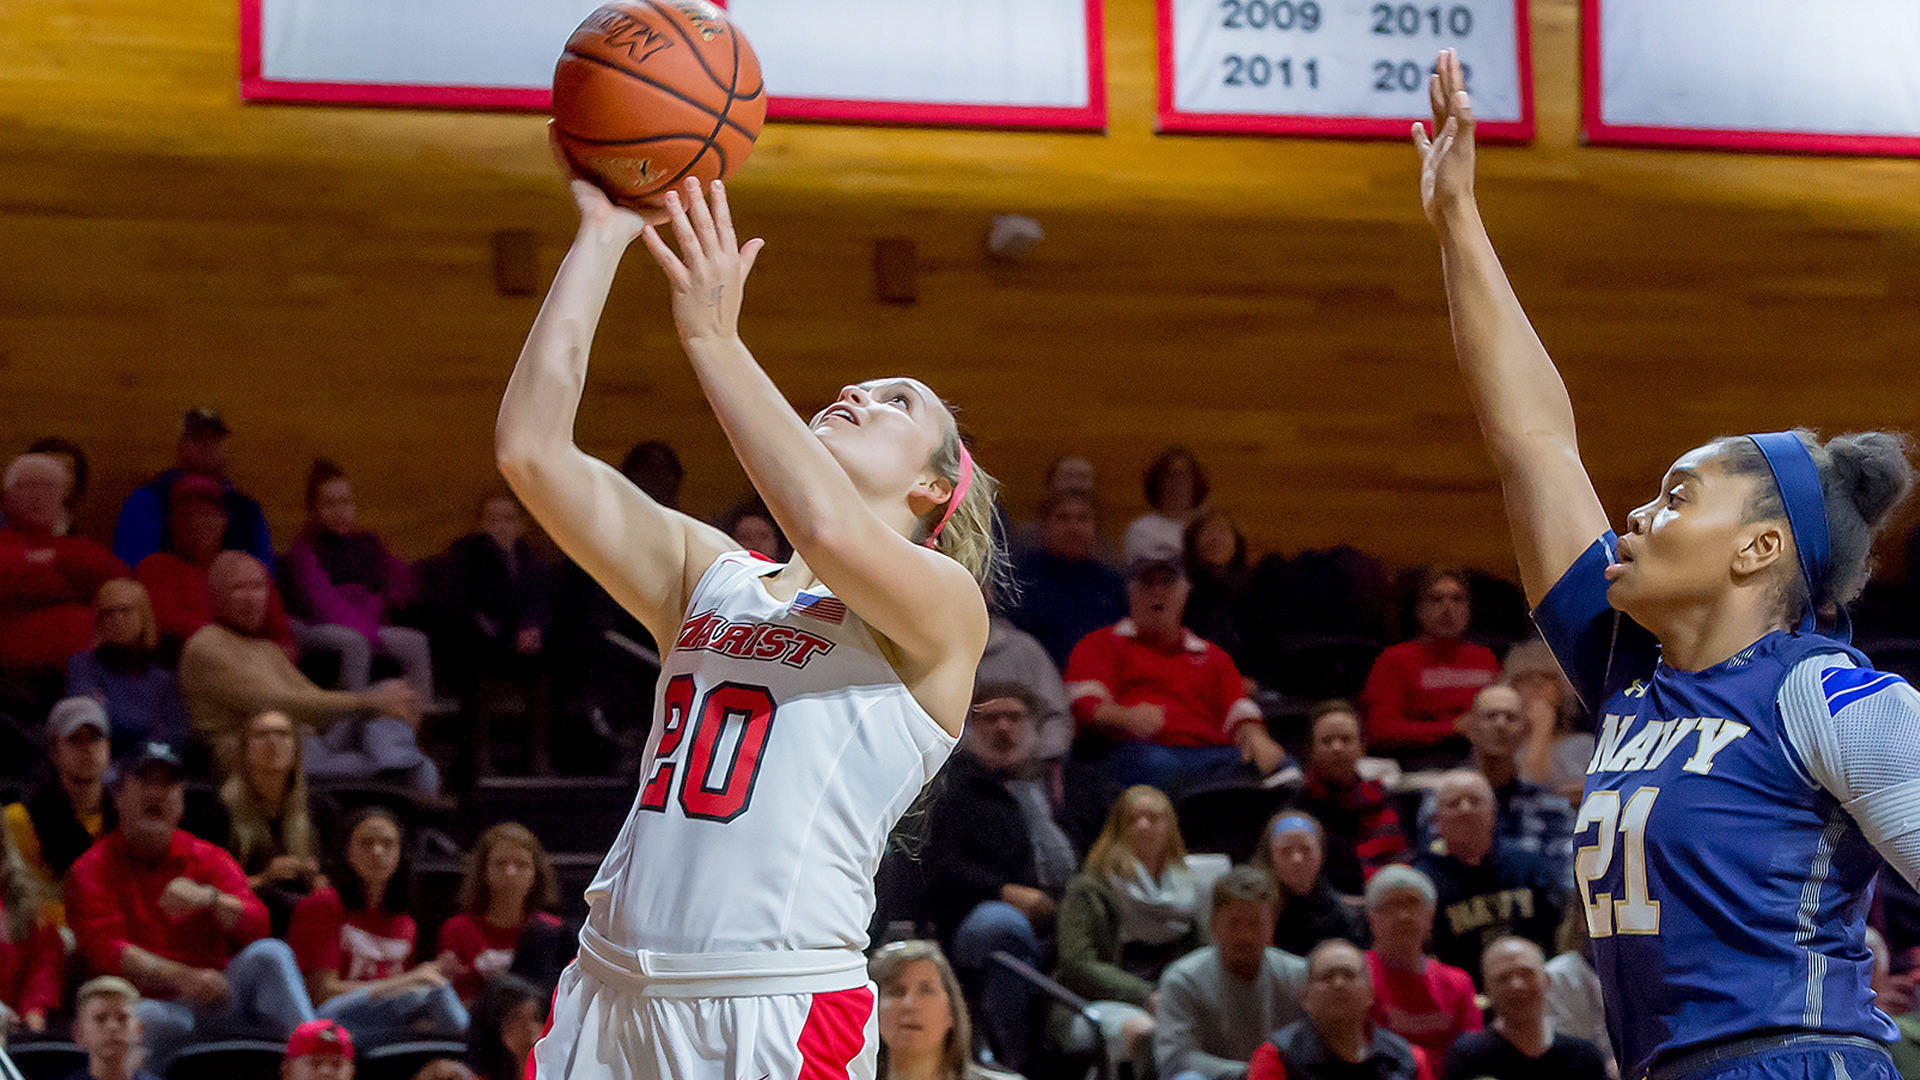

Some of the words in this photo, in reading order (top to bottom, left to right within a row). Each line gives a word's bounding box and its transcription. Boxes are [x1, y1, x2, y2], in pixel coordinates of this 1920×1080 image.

[1221, 0, 1321, 32] 2009
[1371, 4, 1473, 37] 2010
[1223, 55, 1319, 90] 2011
[1372, 60, 1473, 94] 20
[638, 673, 778, 824] 20
[1586, 713, 1751, 775] NAVY
[1574, 786, 1661, 938] 21
